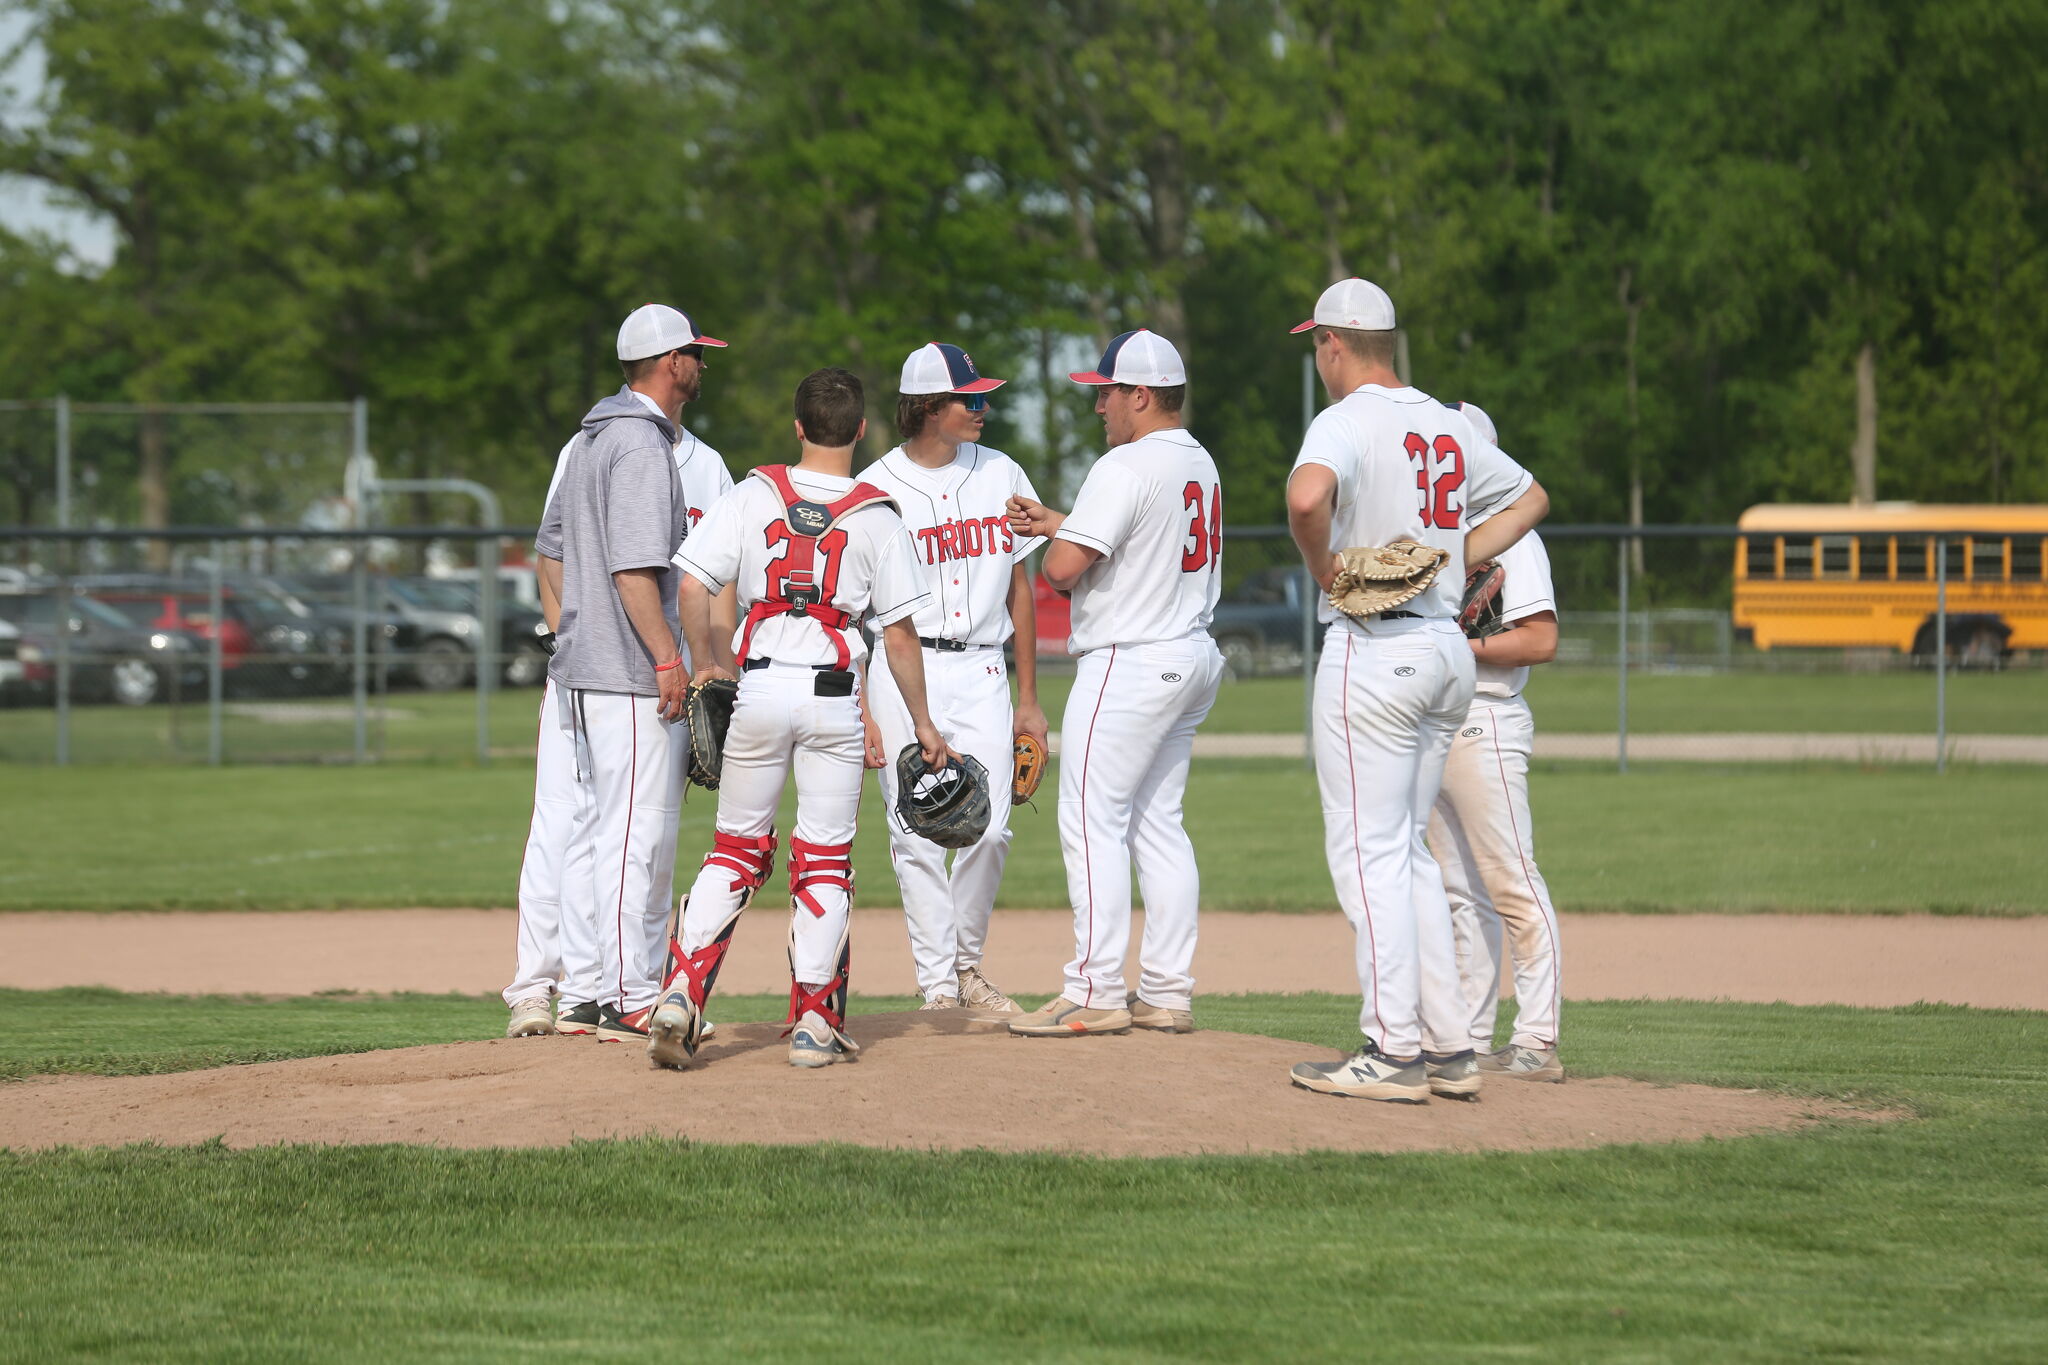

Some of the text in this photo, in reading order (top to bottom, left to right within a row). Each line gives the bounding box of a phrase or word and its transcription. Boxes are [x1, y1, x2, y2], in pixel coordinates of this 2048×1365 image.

[1403, 432, 1466, 529] 32
[764, 518, 849, 608] 21
[909, 515, 1014, 566] TRIOTS
[1182, 481, 1221, 574] 34
[1350, 1063, 1379, 1083] N
